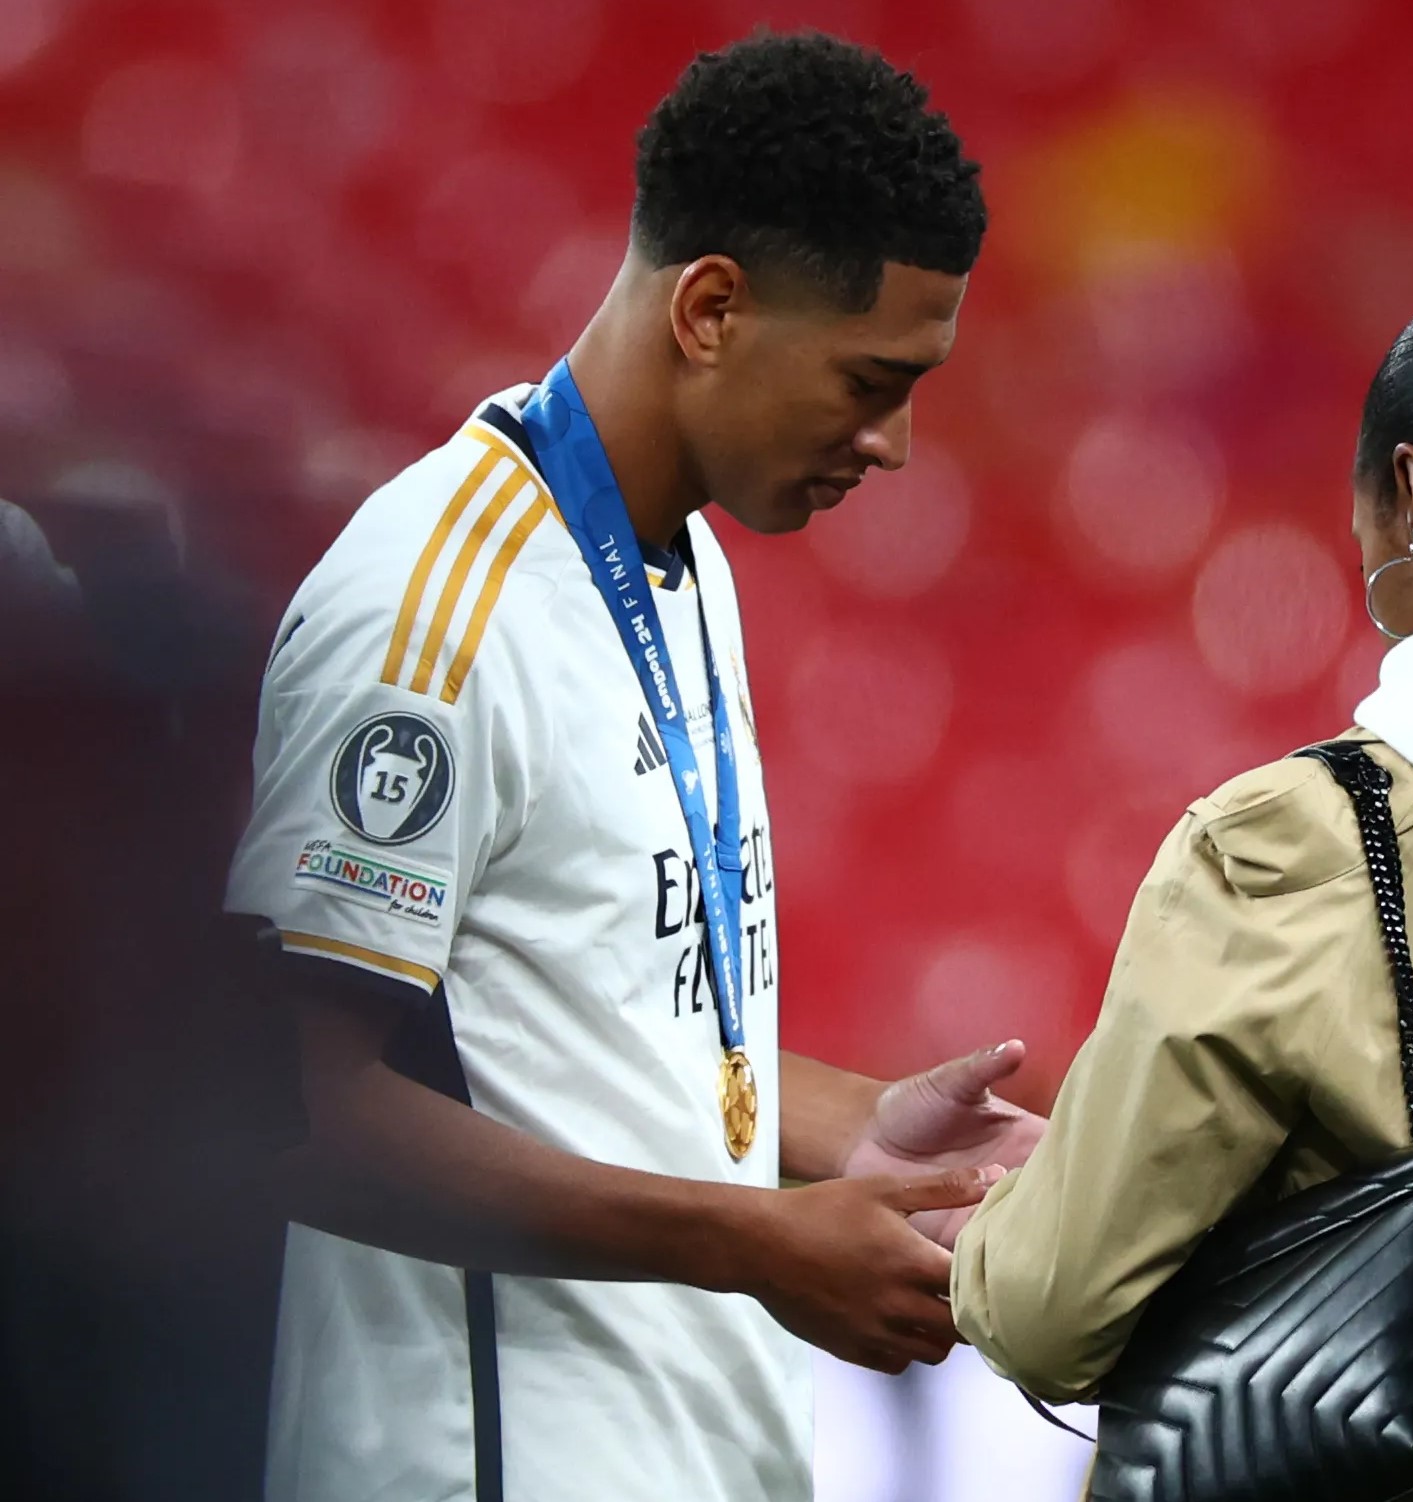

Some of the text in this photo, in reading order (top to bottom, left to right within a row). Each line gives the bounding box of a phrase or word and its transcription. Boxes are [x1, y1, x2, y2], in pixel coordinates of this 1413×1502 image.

[599, 534, 638, 609] FINAL
[631, 613, 652, 644] 24
[370, 771, 408, 803] 15
[305, 839, 332, 851] UEFA
[388, 899, 438, 921] for children
